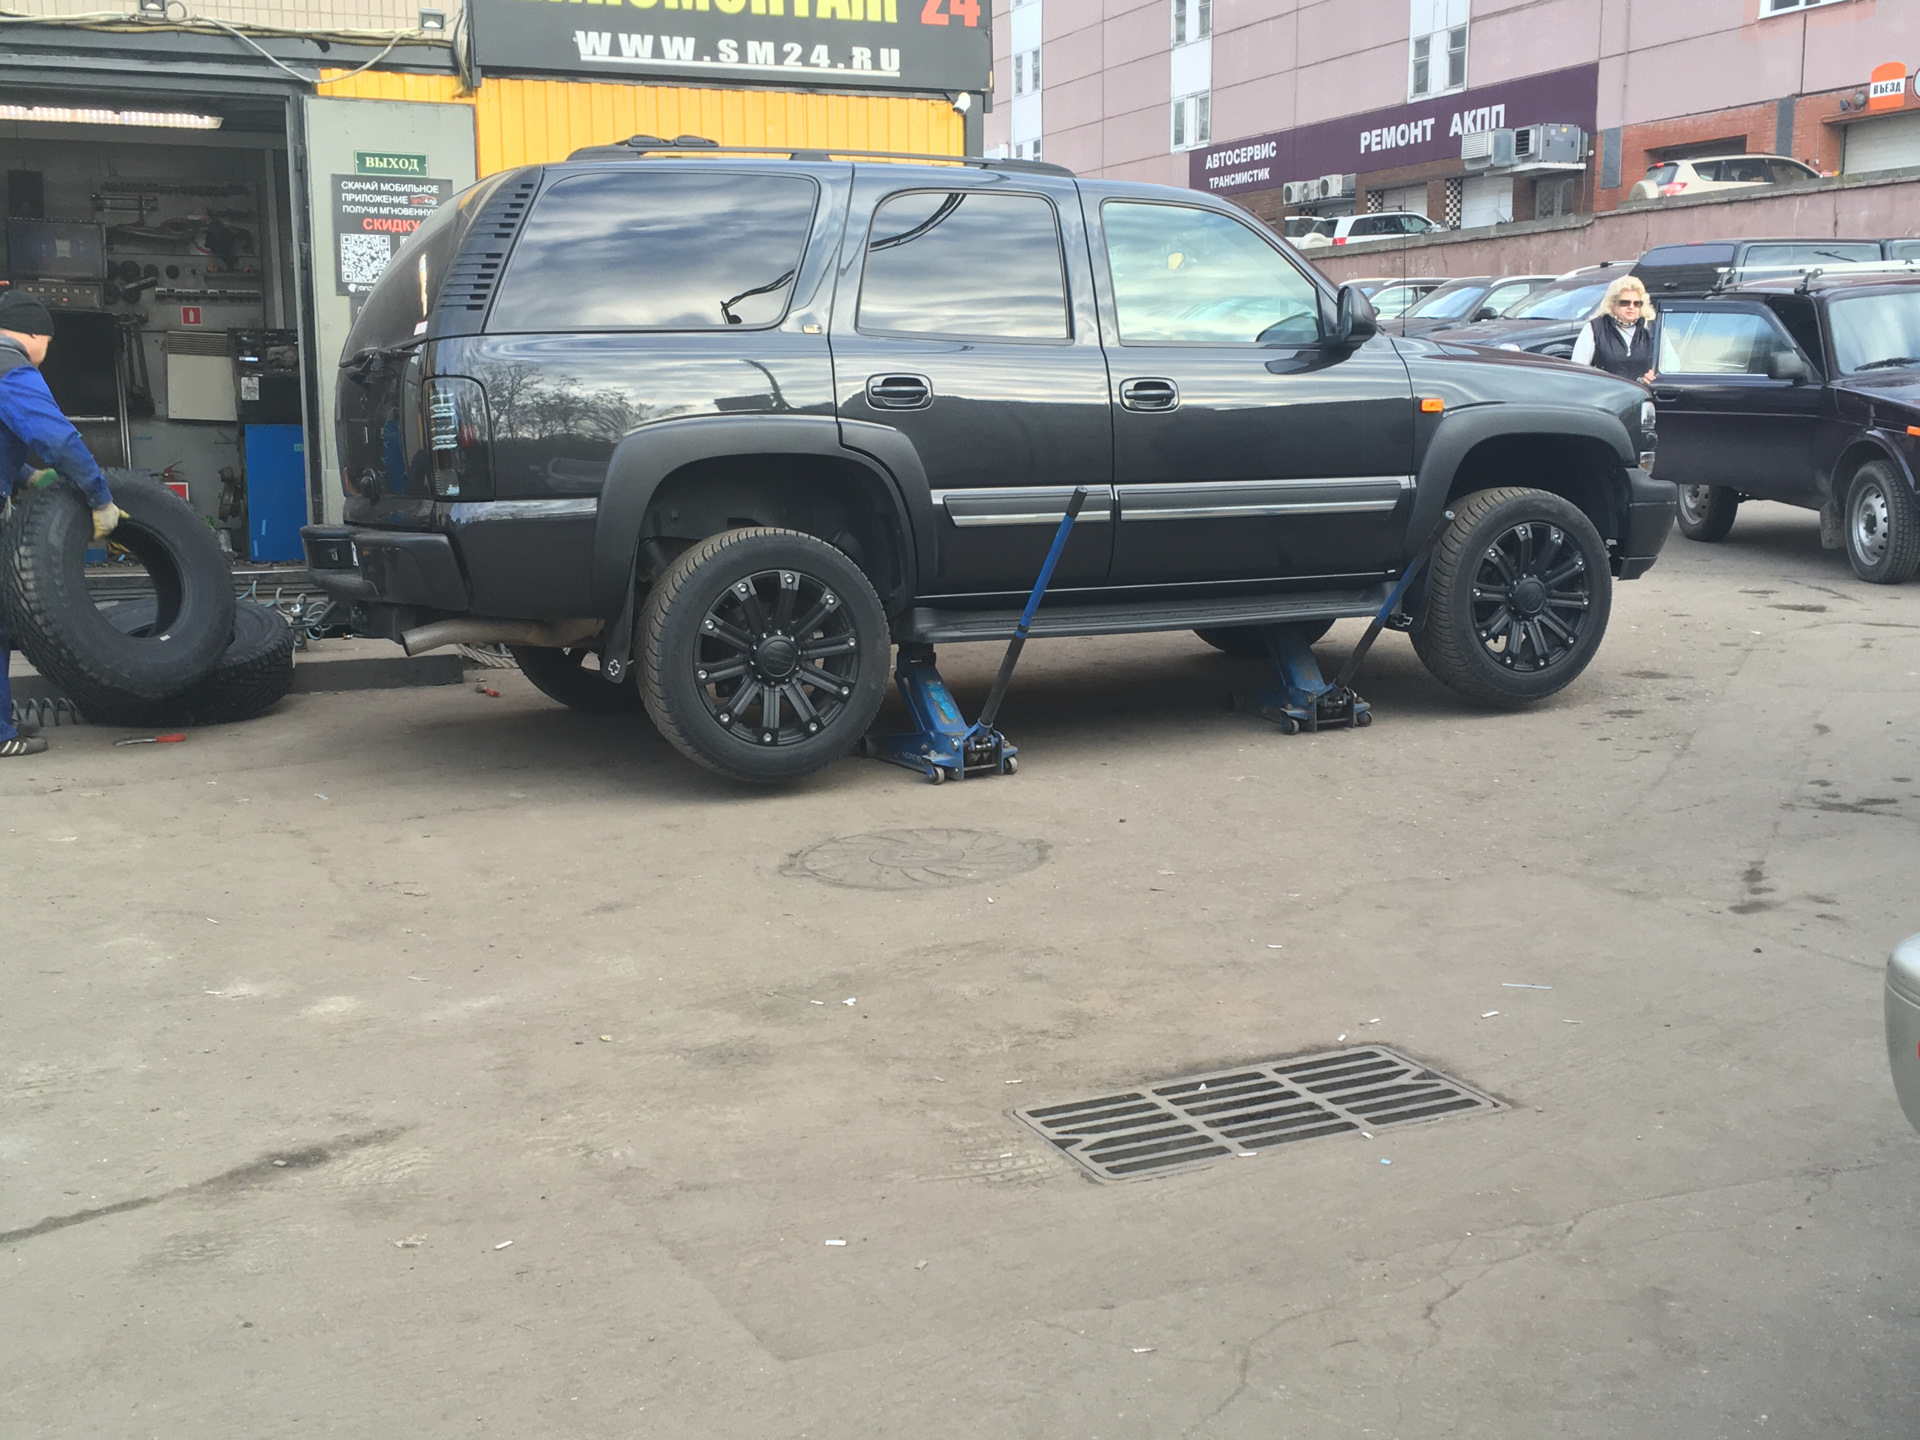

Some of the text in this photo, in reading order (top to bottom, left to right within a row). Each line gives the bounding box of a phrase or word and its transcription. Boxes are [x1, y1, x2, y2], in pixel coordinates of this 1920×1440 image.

[575, 30, 900, 73] WWW.SM24.RU
[1873, 81, 1901, 95] ВЪЕЗД
[1360, 104, 1505, 154] РЕМОНТ АКПП
[1205, 141, 1277, 170] АВТОСЕРВИС
[365, 156, 420, 172] ВЫХОД
[1209, 167, 1270, 189] ТРАНСМИСТИК
[341, 181, 439, 194] СКАЧАЙ МОБИЛЬНОЕ
[341, 193, 409, 204] ПРИЛОЖЕНИЕ
[342, 205, 436, 217] ПОЛУЧИ МГНОВЕННУ
[362, 218, 420, 233] СКИДКУ
